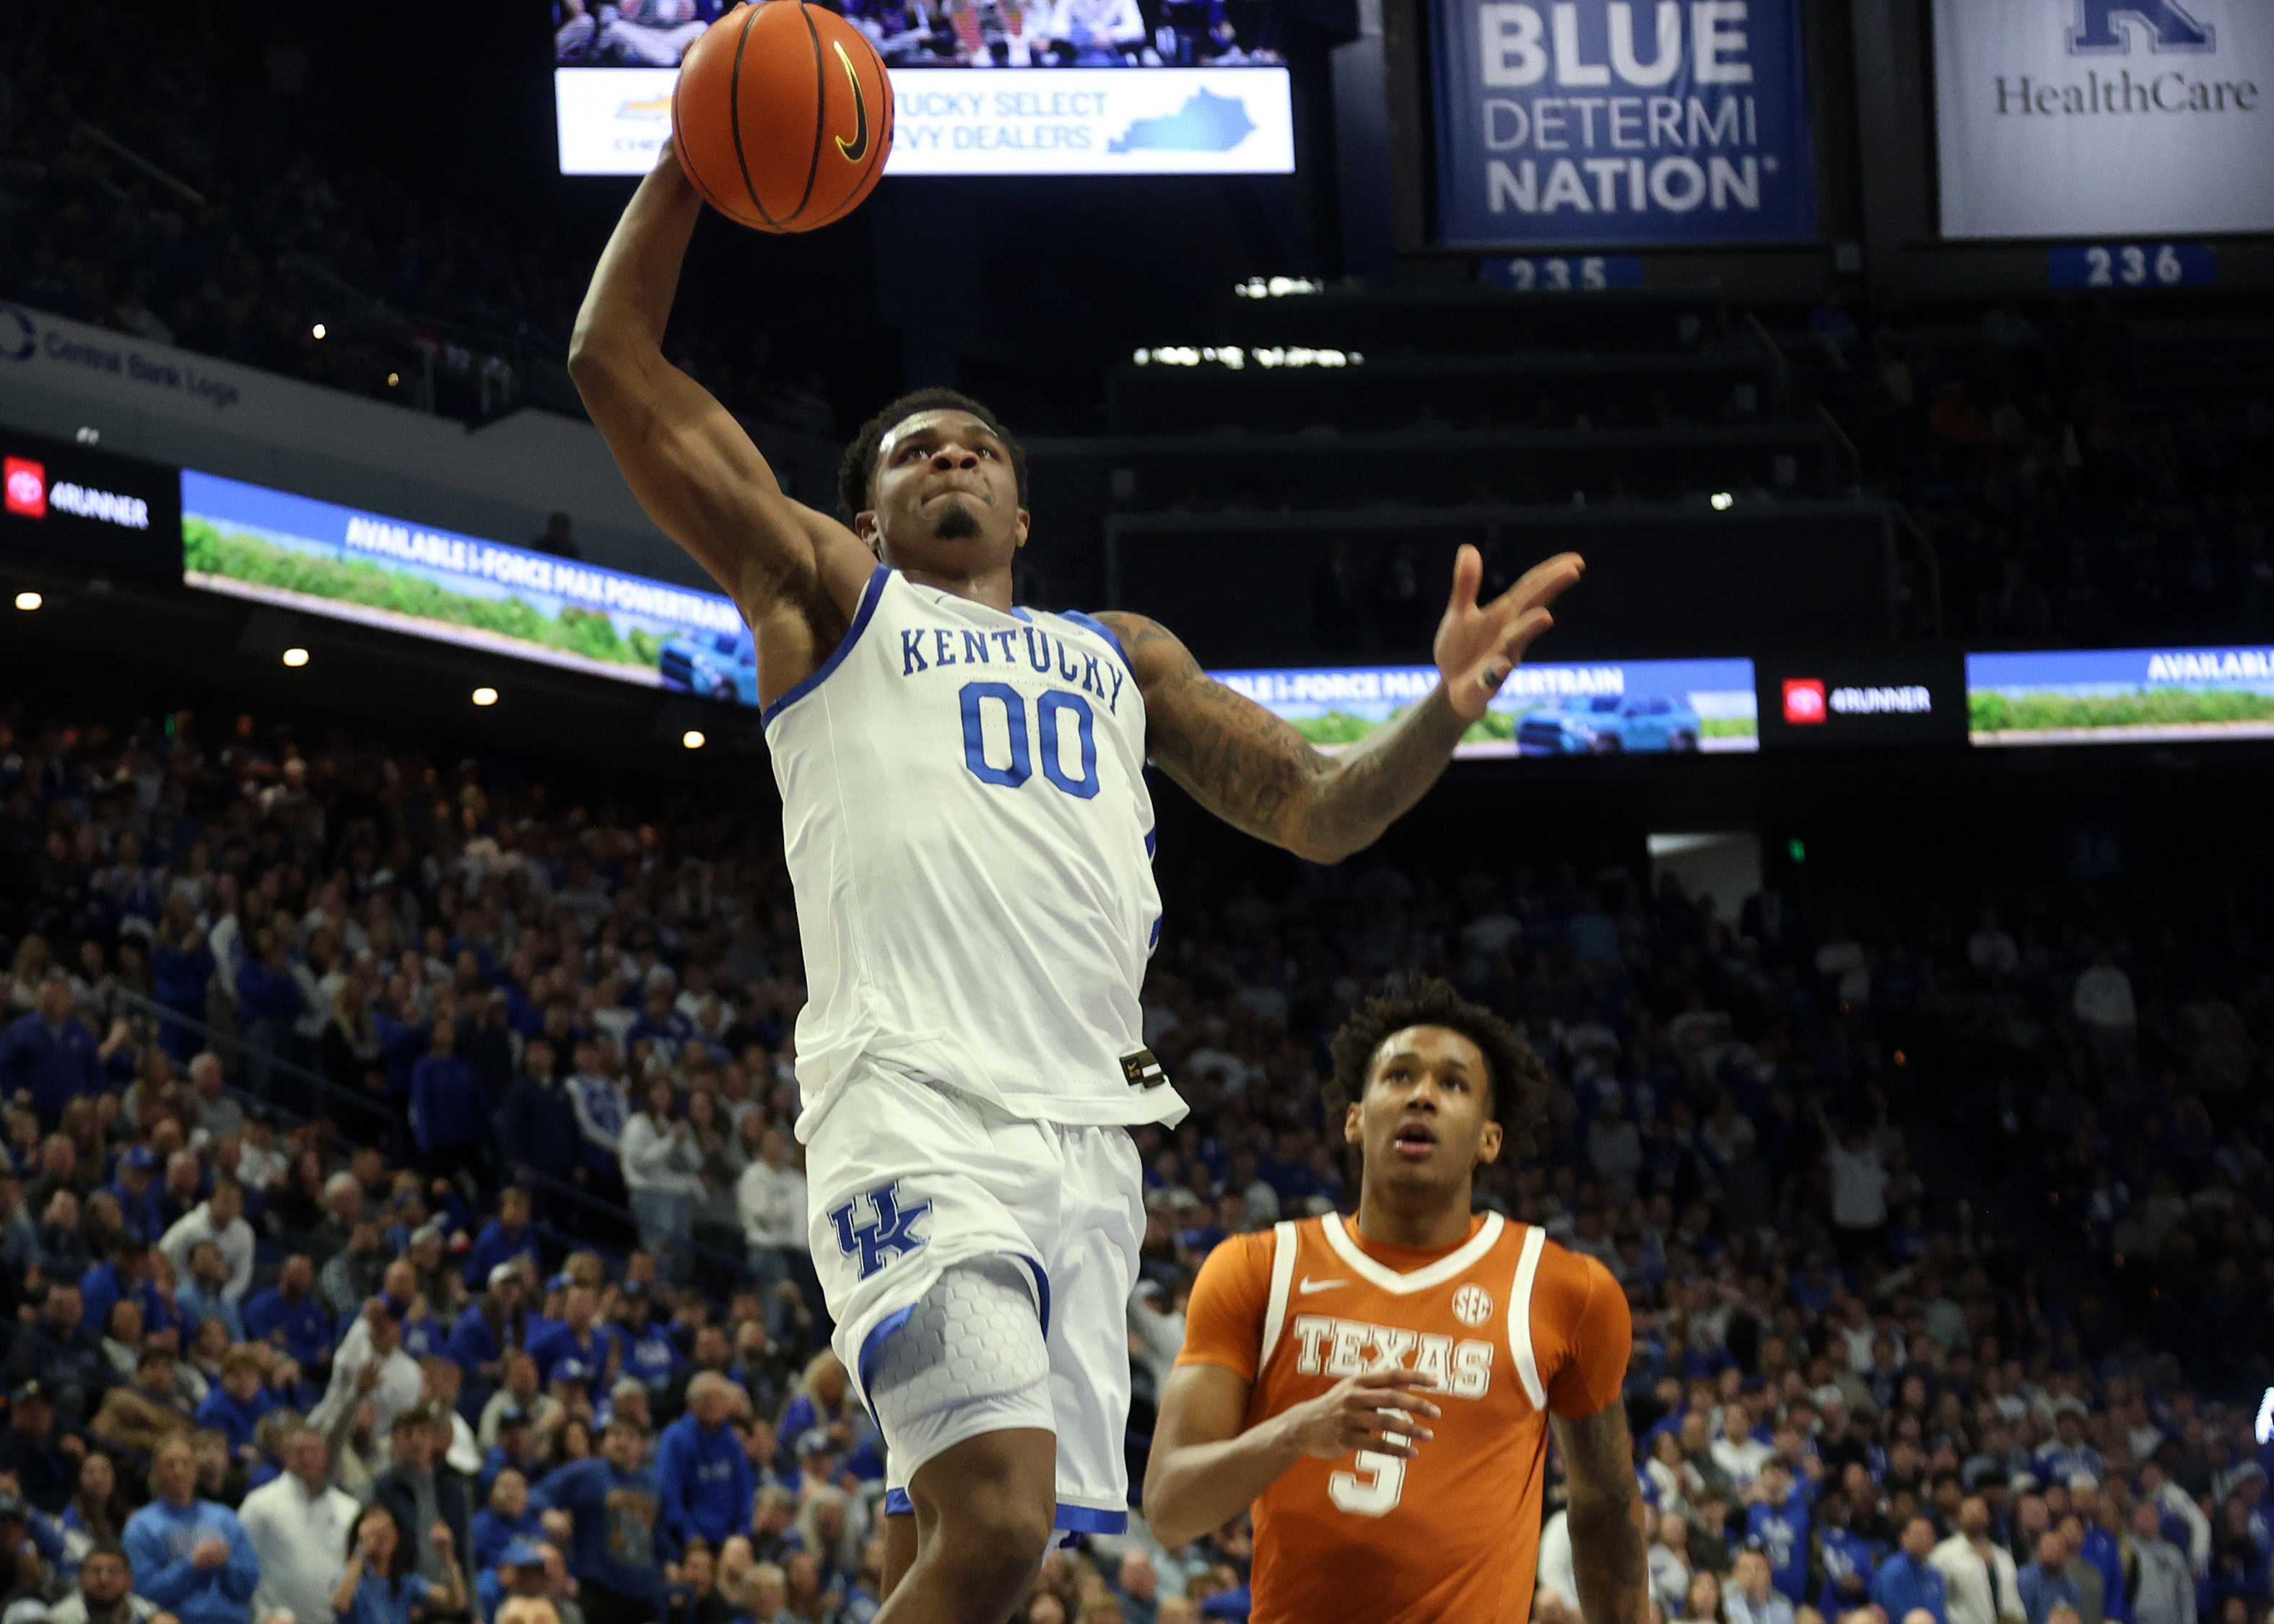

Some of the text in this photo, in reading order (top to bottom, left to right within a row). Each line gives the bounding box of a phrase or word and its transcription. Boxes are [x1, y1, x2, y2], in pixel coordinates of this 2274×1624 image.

[1480, 1, 1754, 87] BLUE
[894, 91, 1109, 116] UCKY SELECT
[1996, 70, 2260, 115] HealthCare
[953, 125, 1092, 149] DEALERS
[1482, 95, 1757, 150] DETERMI
[1508, 256, 1607, 289] 235
[2085, 245, 2183, 286] 236
[44, 330, 122, 373] Central
[128, 352, 180, 388] Bank
[49, 480, 149, 530] 4RUNNER
[346, 515, 467, 570] AVAILABLE
[554, 563, 605, 602] MAX
[605, 576, 741, 633] POWERTRAIN
[901, 627, 1123, 717] KENTUCKY
[1829, 686, 1932, 714] 4RUNNER
[959, 681, 1100, 800] 00
[1453, 1284, 1492, 1326] SEC
[1294, 1314, 1494, 1400] TEXAS
